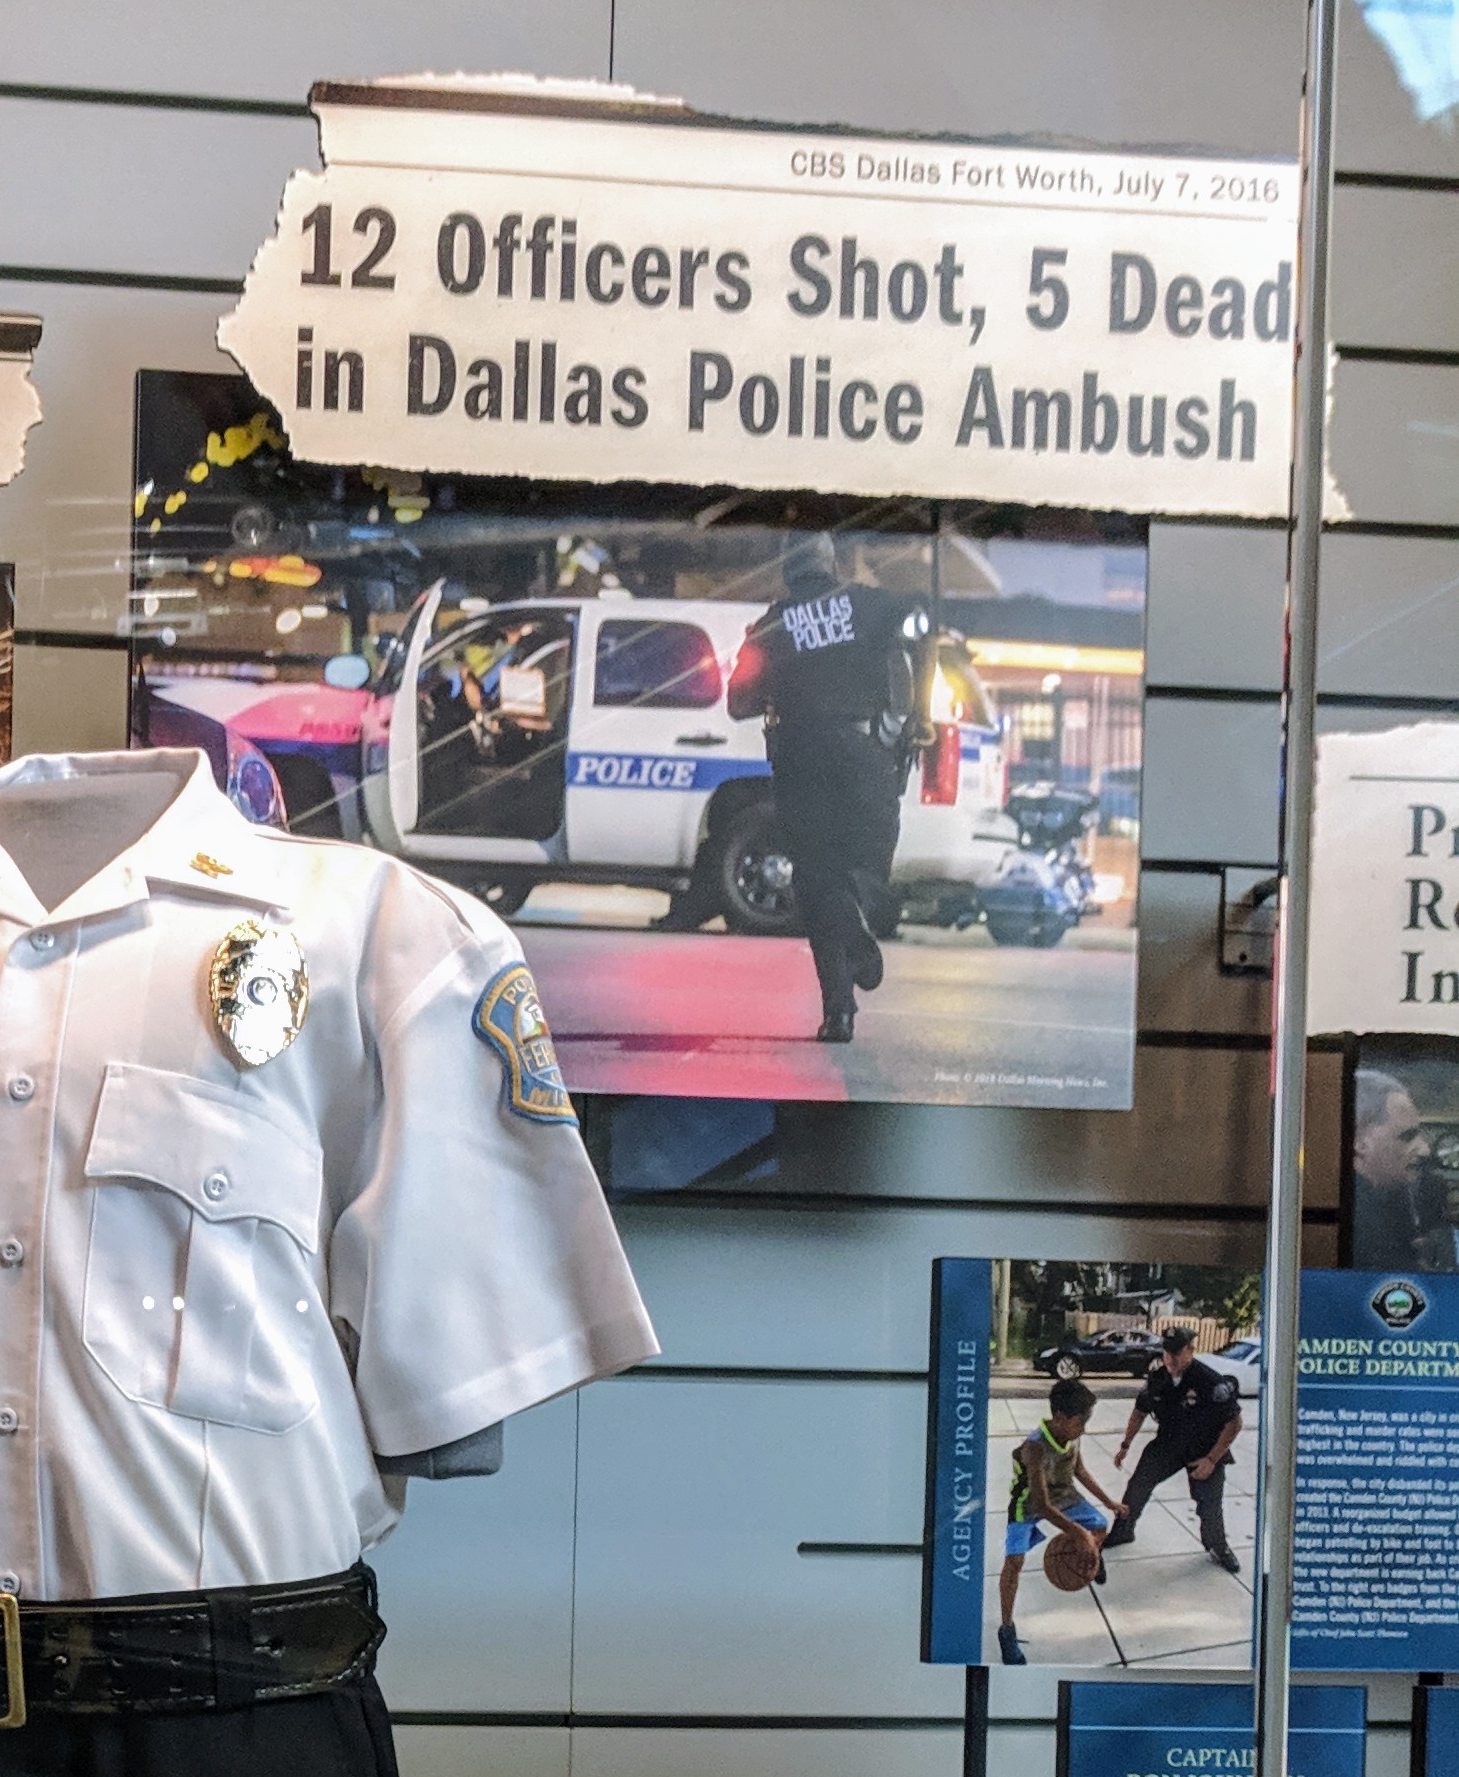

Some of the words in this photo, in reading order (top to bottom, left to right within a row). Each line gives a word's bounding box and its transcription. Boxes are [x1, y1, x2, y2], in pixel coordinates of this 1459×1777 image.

[790, 150, 846, 179] CBS
[857, 153, 941, 185] Dallas
[951, 159, 1004, 189] Fort
[1015, 164, 1103, 197] Worth,
[1113, 169, 1165, 202] July
[1176, 173, 1198, 201] 7,
[1210, 175, 1280, 203] 2016
[301, 204, 396, 291] 12
[437, 212, 752, 314] Officers
[788, 234, 985, 344] Shot,
[1027, 248, 1069, 331] 5
[1109, 252, 1291, 342] Dead
[296, 327, 364, 413] in
[407, 334, 648, 429] Dallas
[688, 350, 923, 445] Police
[956, 366, 1256, 462] Ambush
[782, 594, 853, 632] DALLAS
[793, 622, 855, 652] POLICE
[574, 756, 697, 788] POLICE
[1298, 1338, 1373, 1355] AMDEN
[1298, 1358, 1360, 1375] OLICE
[1365, 1359, 1459, 1377] DEPARTM
[955, 1339, 977, 1457] PROFILE
[952, 1466, 973, 1581] AGENCY
